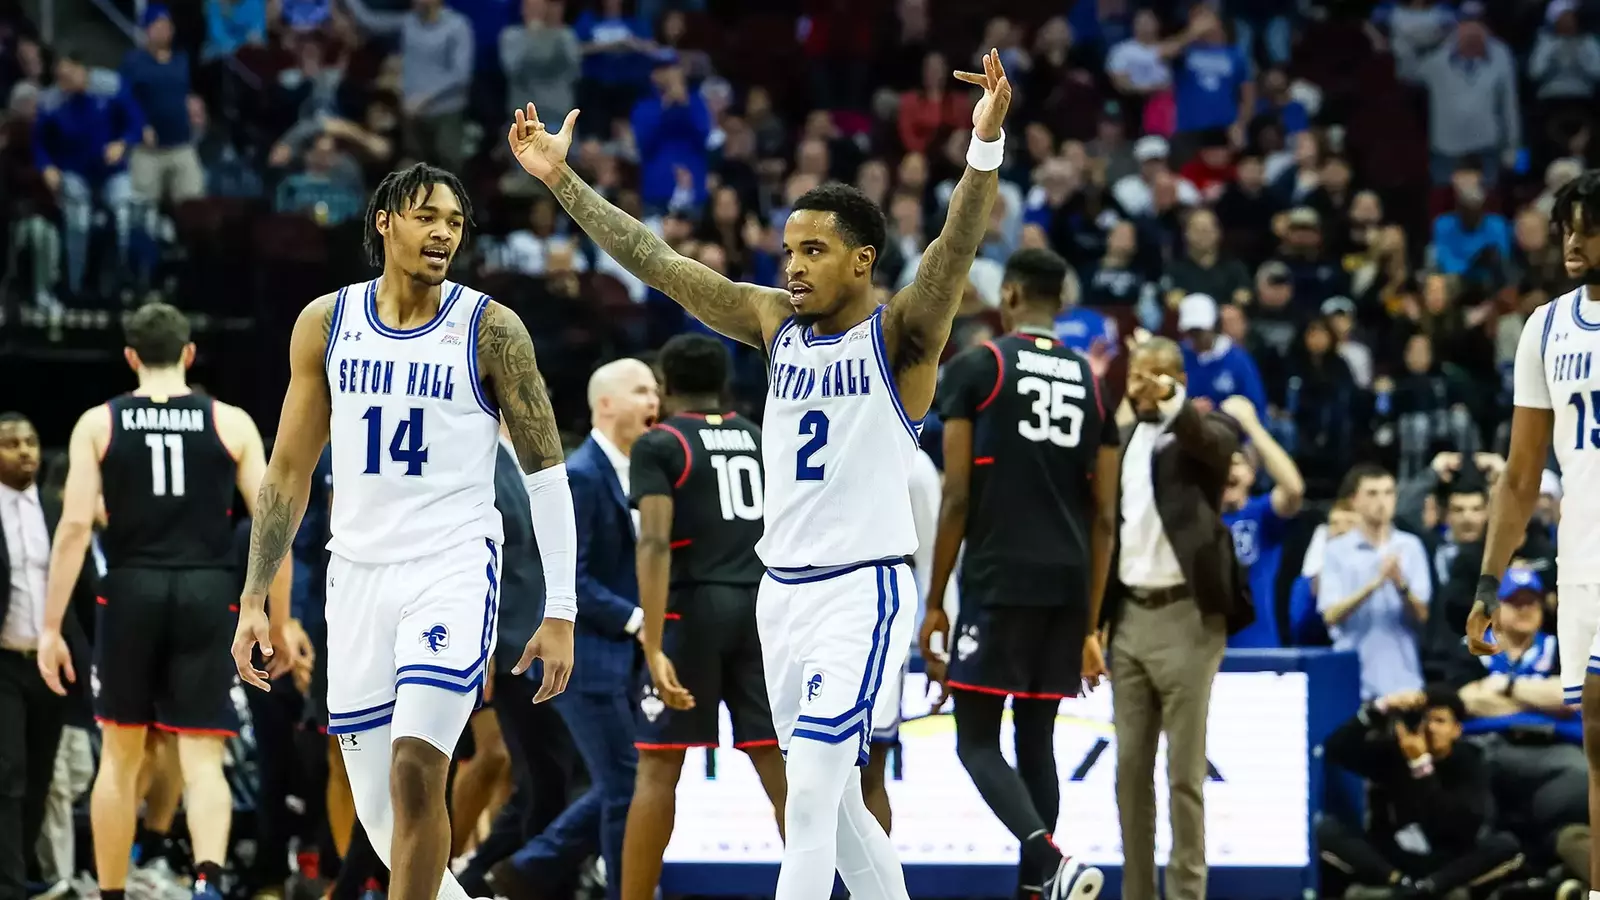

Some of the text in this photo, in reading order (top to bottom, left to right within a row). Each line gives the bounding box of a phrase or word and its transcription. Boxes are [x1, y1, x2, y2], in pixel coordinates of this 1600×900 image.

[339, 358, 455, 401] SETON HALL
[821, 357, 871, 399] HALL
[1016, 375, 1086, 448] 35
[144, 432, 186, 497] 11
[361, 405, 430, 477] 14
[795, 409, 831, 482] 2
[709, 454, 764, 521] 10
